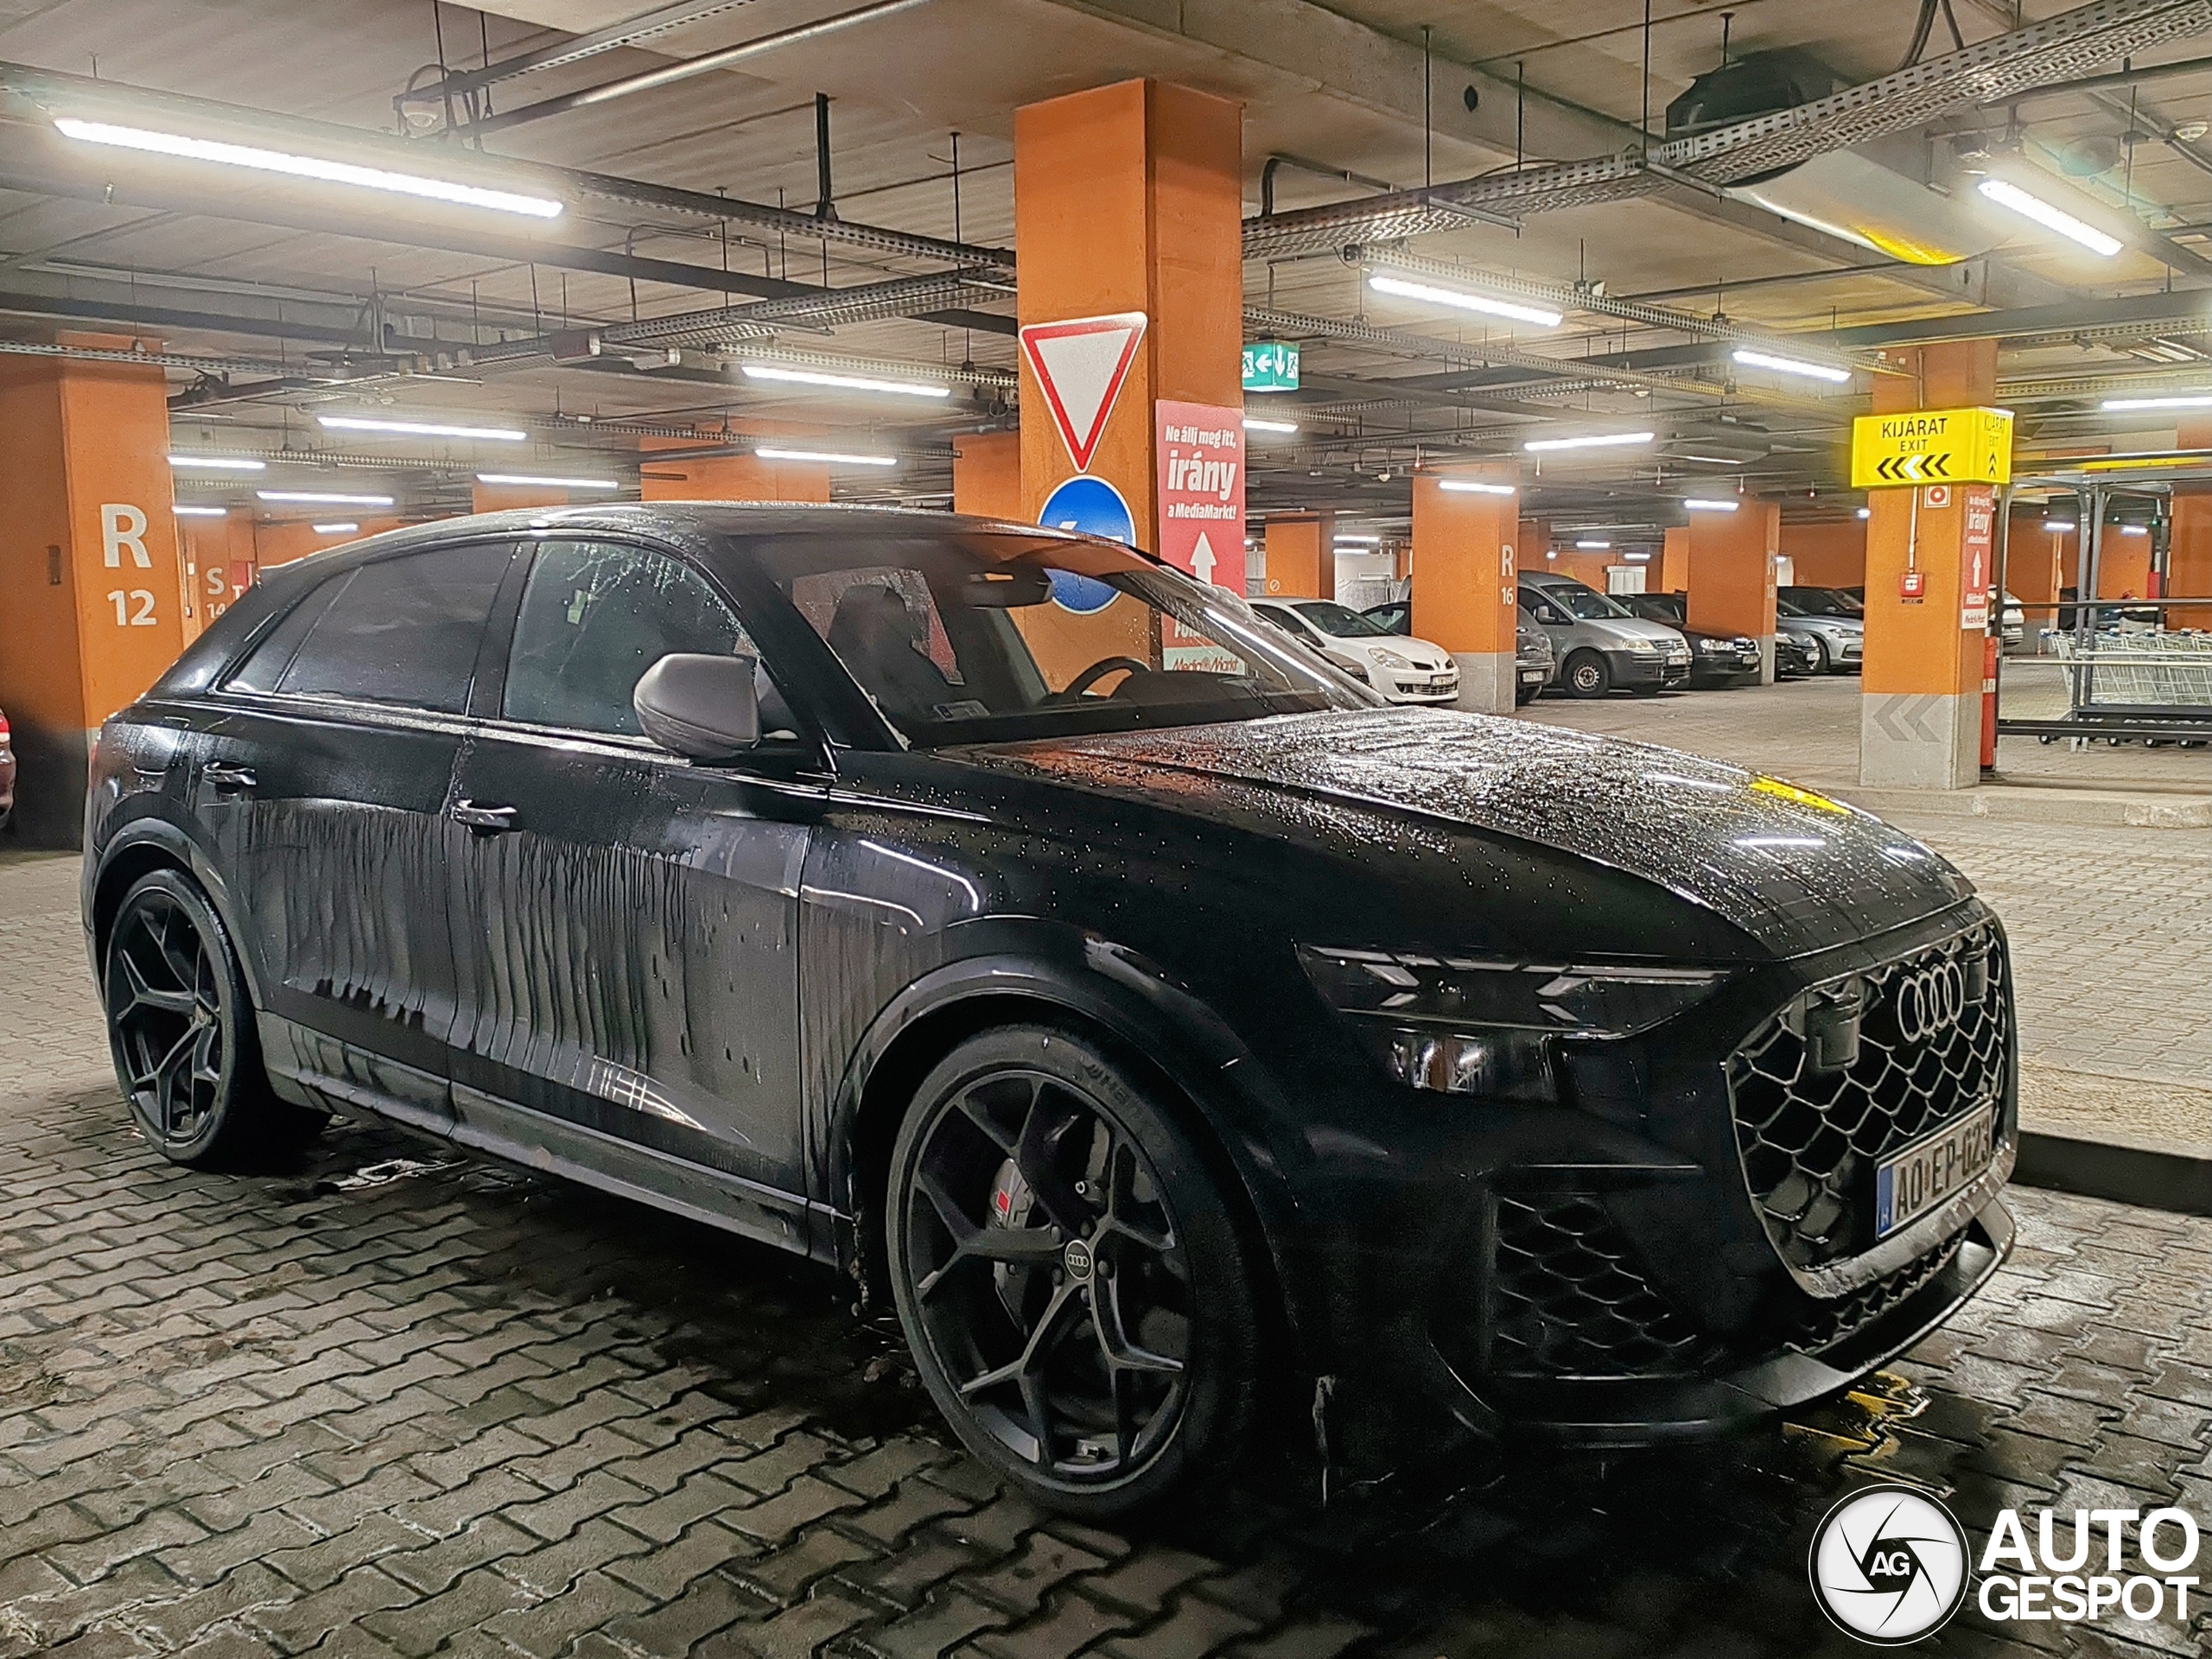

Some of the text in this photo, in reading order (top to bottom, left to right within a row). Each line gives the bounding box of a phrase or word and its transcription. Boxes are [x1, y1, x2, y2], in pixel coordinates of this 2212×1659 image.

[1166, 425, 1236, 449] Ne állj meg itt,
[1882, 416, 1948, 439] KIJÁRAT
[1900, 439, 1929, 452] EXIT
[1167, 449, 1236, 501] irány
[1167, 503, 1236, 520] a MediaMarkt!
[101, 504, 152, 569] R
[1502, 544, 1514, 576] R
[207, 567, 225, 595] S
[107, 589, 157, 626] 12
[1501, 587, 1514, 605] 16
[1211, 656, 1238, 672] Markt
